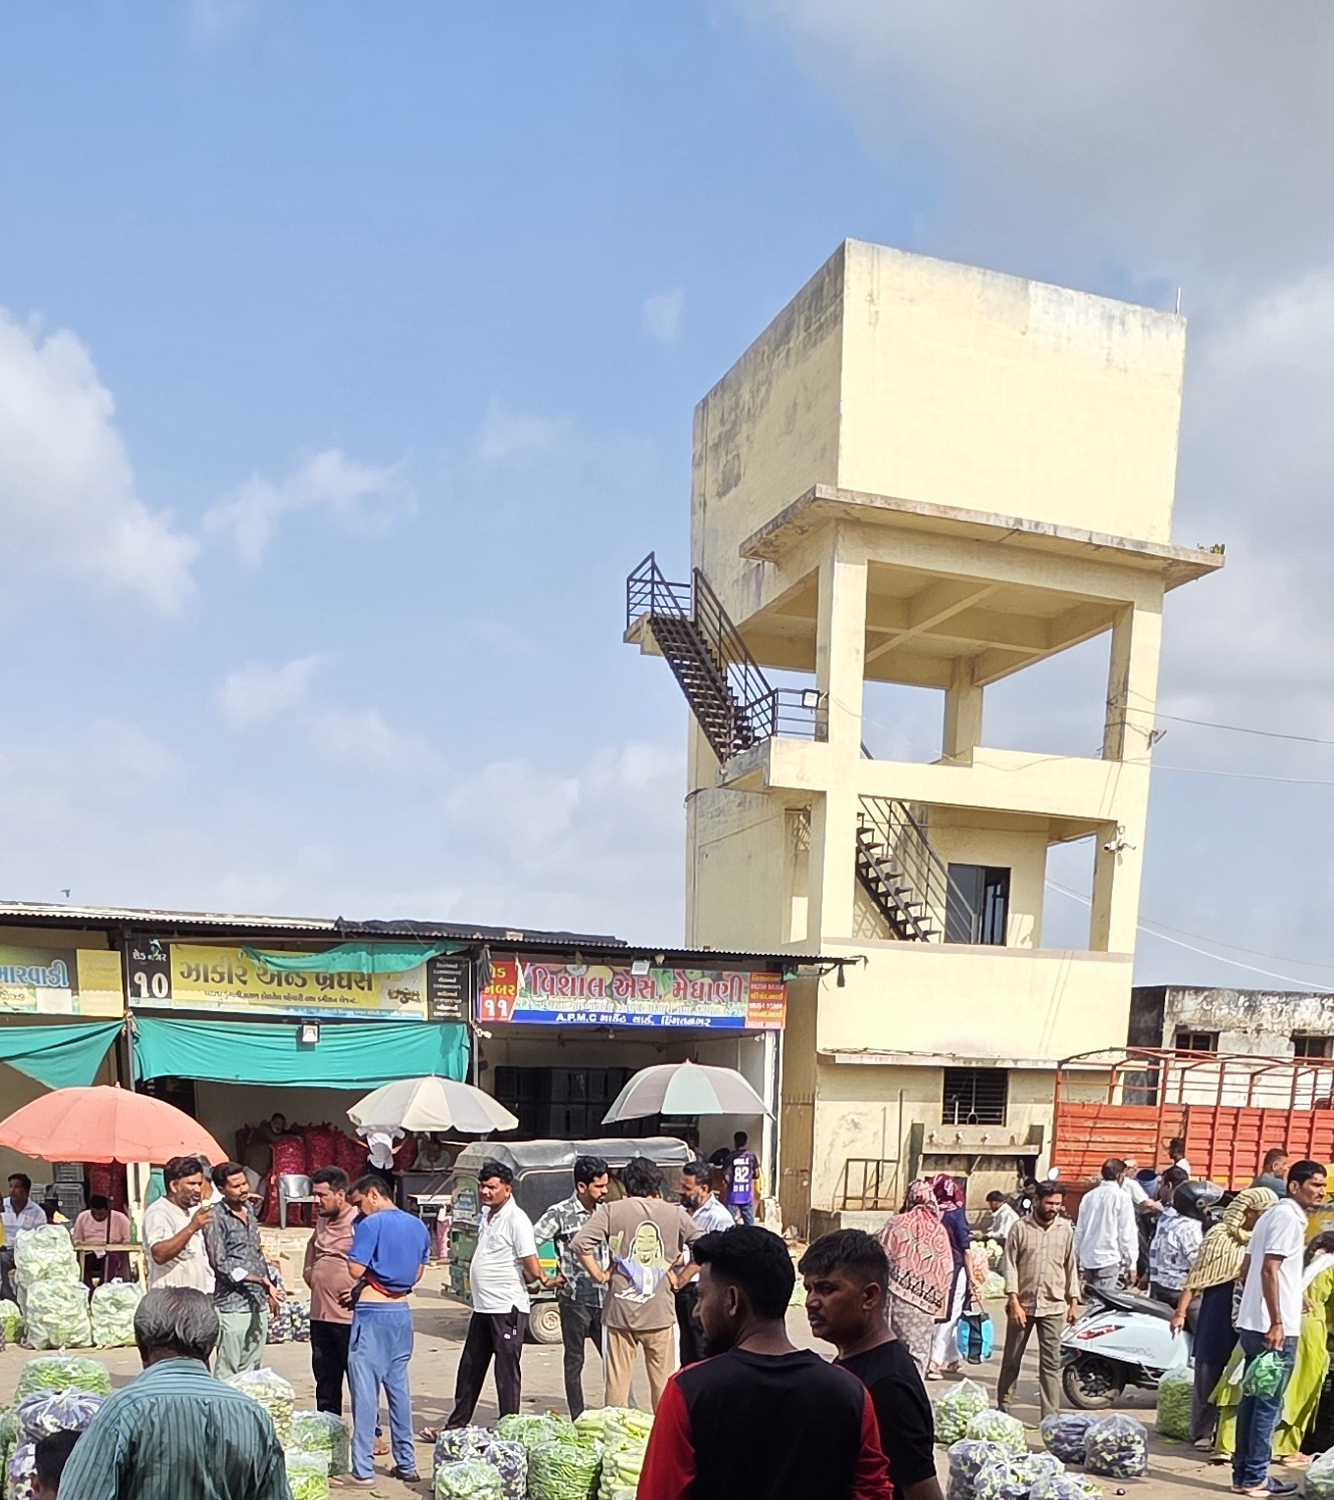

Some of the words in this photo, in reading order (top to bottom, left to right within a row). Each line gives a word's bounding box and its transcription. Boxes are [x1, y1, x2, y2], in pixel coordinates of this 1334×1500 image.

[179, 955, 249, 986] ઝાકીર
[133, 971, 169, 999] ૧૦
[529, 966, 606, 999] વિશાલ
[672, 967, 744, 1004] મેઘાણી
[484, 999, 508, 1018] ૧૧
[734, 1166, 750, 1183] 82
